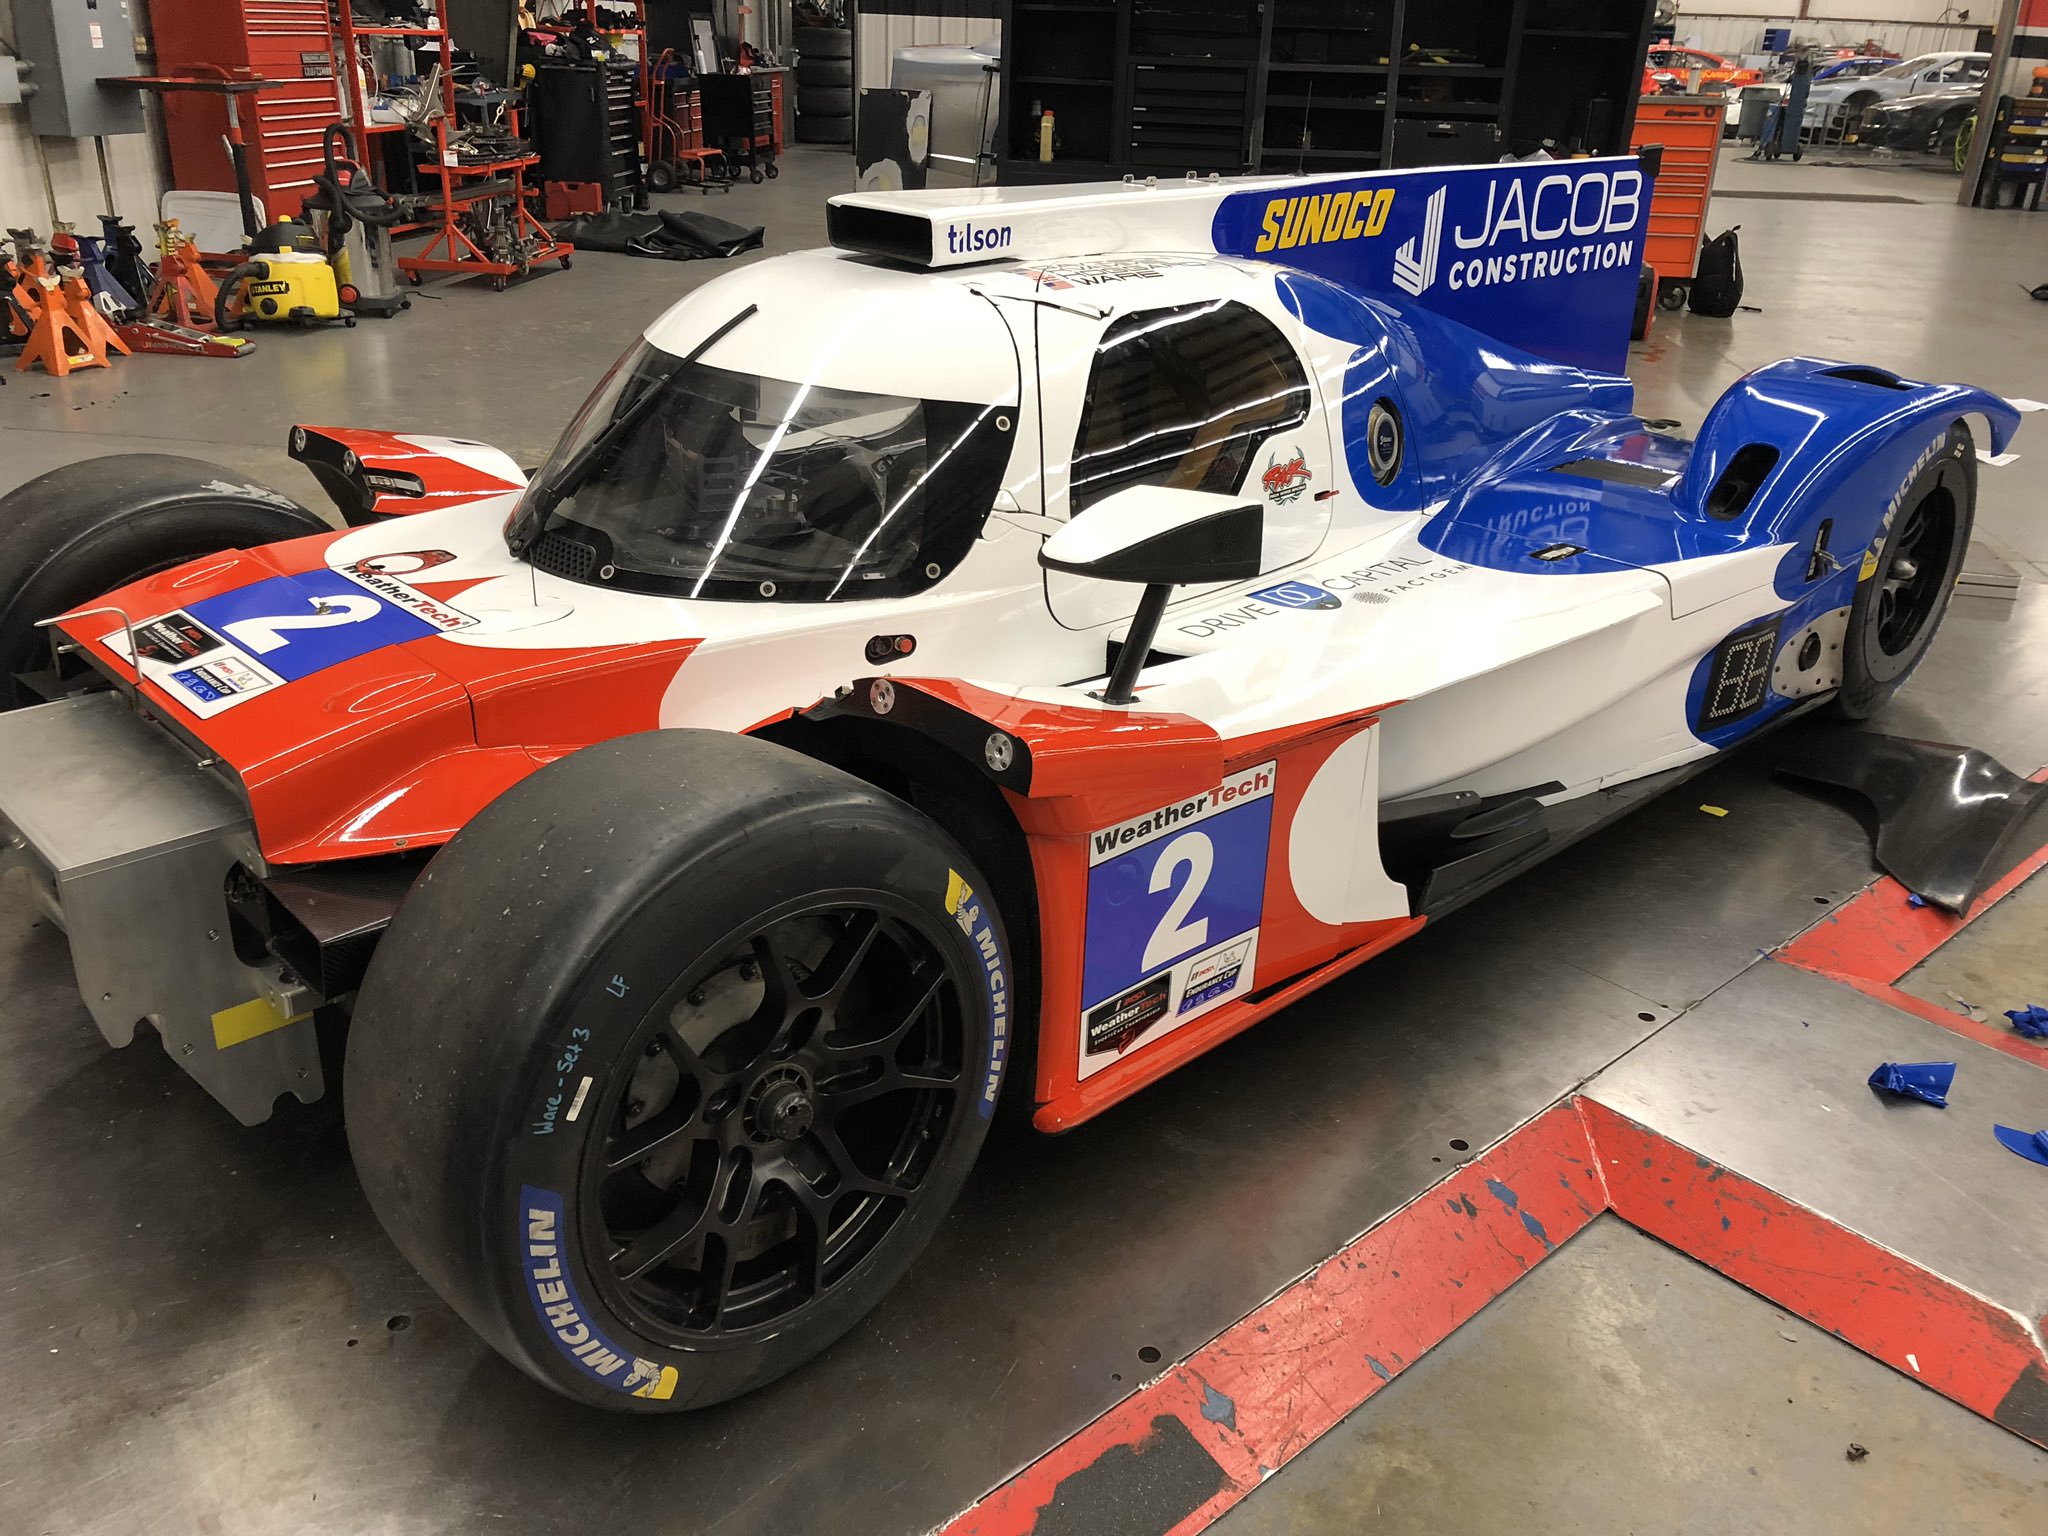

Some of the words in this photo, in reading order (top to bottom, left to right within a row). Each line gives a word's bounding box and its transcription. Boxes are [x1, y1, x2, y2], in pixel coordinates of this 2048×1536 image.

[948, 223, 1012, 254] tilson
[1255, 188, 1396, 253] SUNOCO
[1455, 170, 1643, 250] JACOB
[1071, 270, 1164, 286] WARE
[1449, 240, 1634, 291] CONSTRUCTION
[1882, 432, 1946, 531] MICHELIN
[1178, 603, 1281, 638] DRIVE
[1321, 556, 1433, 591] CAPITAL
[1383, 564, 1474, 595] FACTGEM
[221, 594, 382, 655] 2
[1141, 831, 1214, 974] 2
[605, 974, 631, 999] LF
[975, 926, 1006, 1102] MICHELIN
[532, 1094, 562, 1135] Ware
[557, 1043, 583, 1074] Set
[572, 1027, 591, 1042] 3
[528, 1208, 627, 1377] MICHELIN
